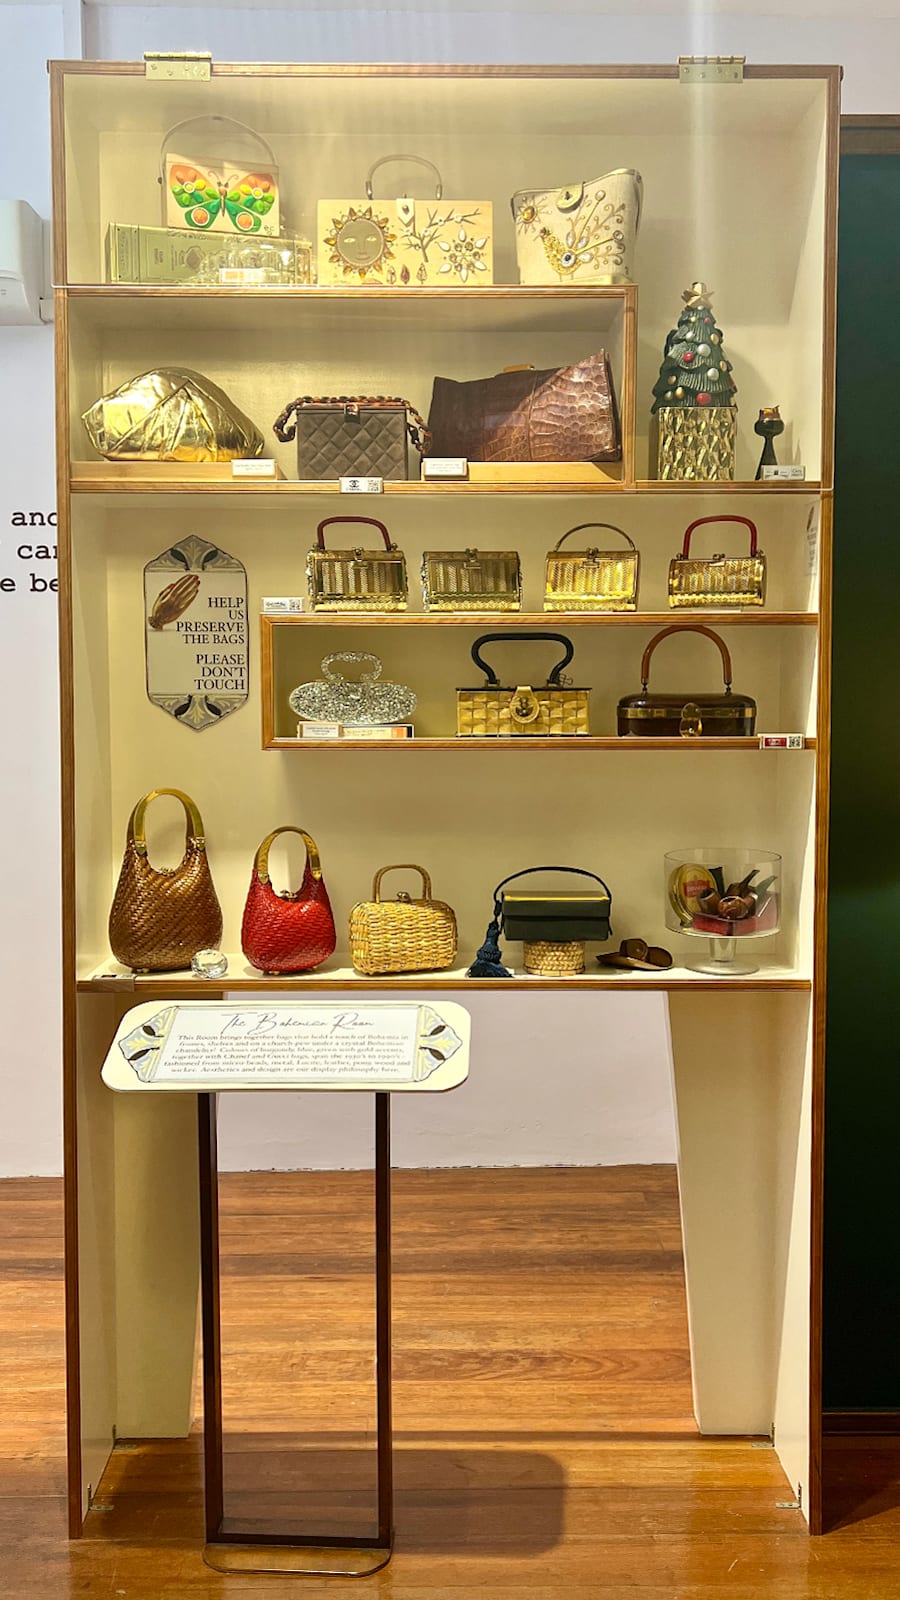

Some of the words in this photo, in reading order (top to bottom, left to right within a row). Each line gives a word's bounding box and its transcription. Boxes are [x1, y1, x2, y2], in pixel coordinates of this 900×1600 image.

[208, 597, 244, 608] HELP
[229, 610, 244, 620] US
[176, 622, 244, 632] PRESERVE
[182, 634, 209, 644] THE
[213, 634, 245, 645] BAGS
[196, 654, 245, 665] PLEASE
[202, 666, 246, 677] DON'T
[194, 679, 245, 690] TOUCH
[247, 1011, 327, 1035] Bohemian
[330, 1012, 374, 1034] Room
